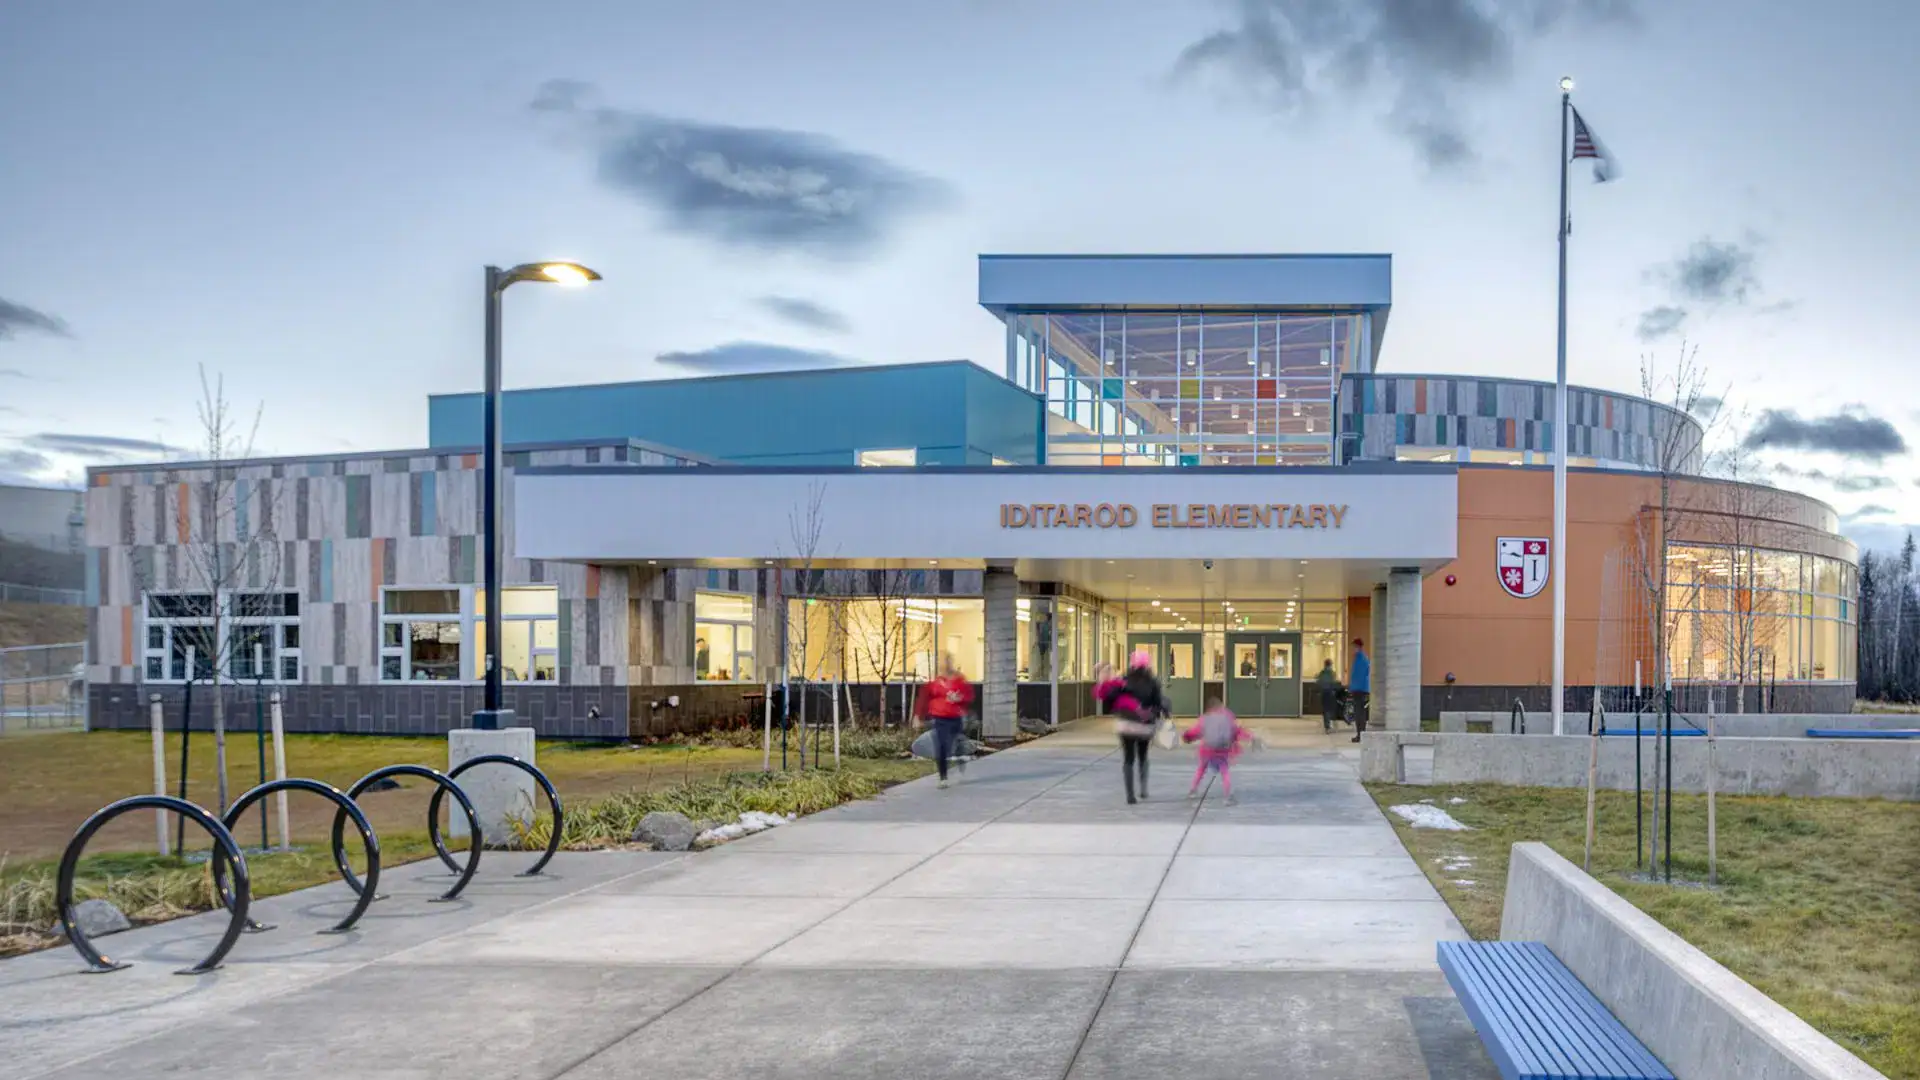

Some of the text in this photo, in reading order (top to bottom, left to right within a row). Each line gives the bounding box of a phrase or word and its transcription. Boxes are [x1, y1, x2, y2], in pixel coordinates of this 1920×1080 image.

[1000, 503, 1348, 529] IDITAROD ELEMENTARY
[1530, 559, 1540, 581] I
